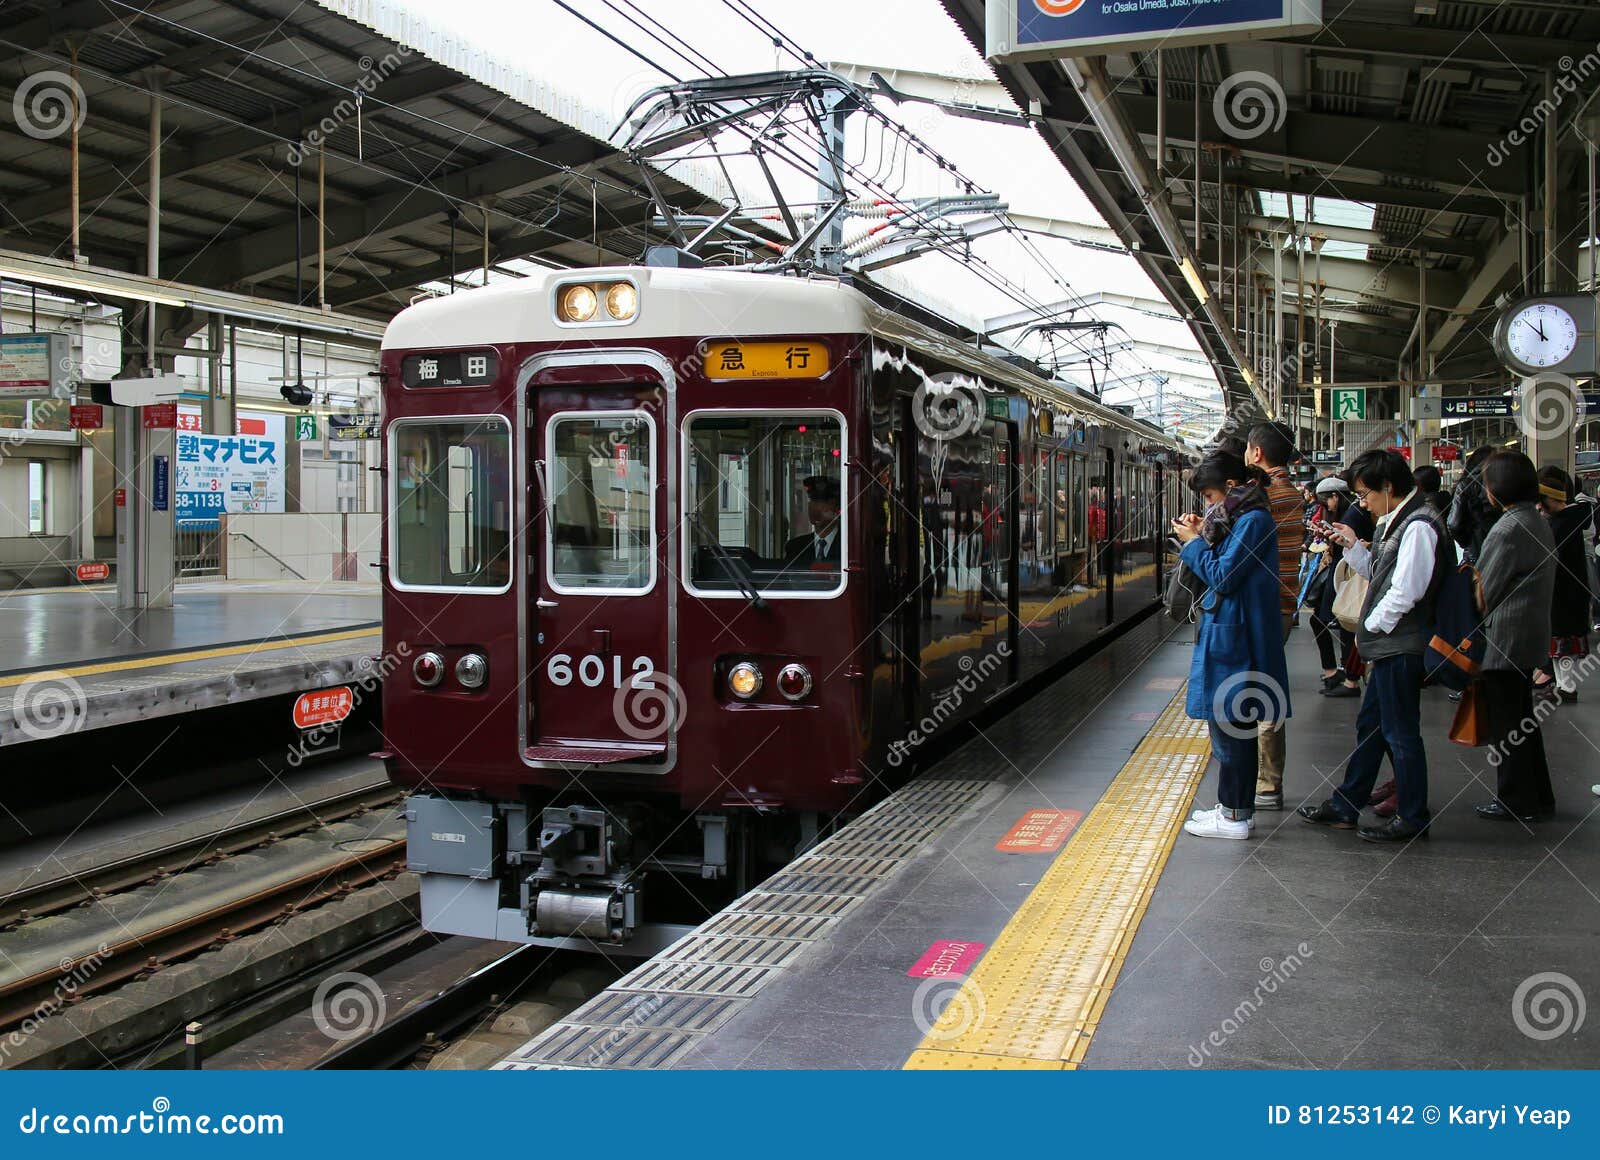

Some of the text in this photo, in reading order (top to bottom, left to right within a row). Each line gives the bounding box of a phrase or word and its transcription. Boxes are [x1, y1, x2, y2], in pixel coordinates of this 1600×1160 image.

[1102, 3, 1112, 14] for
[1113, 1, 1138, 13] Osaka
[1139, 0, 1169, 10] Umeda,
[418, 356, 487, 380] 梅田
[720, 346, 811, 371] 急行
[177, 415, 201, 431] 大学
[176, 434, 276, 465] 塾マナビス
[547, 653, 656, 690] 6012
